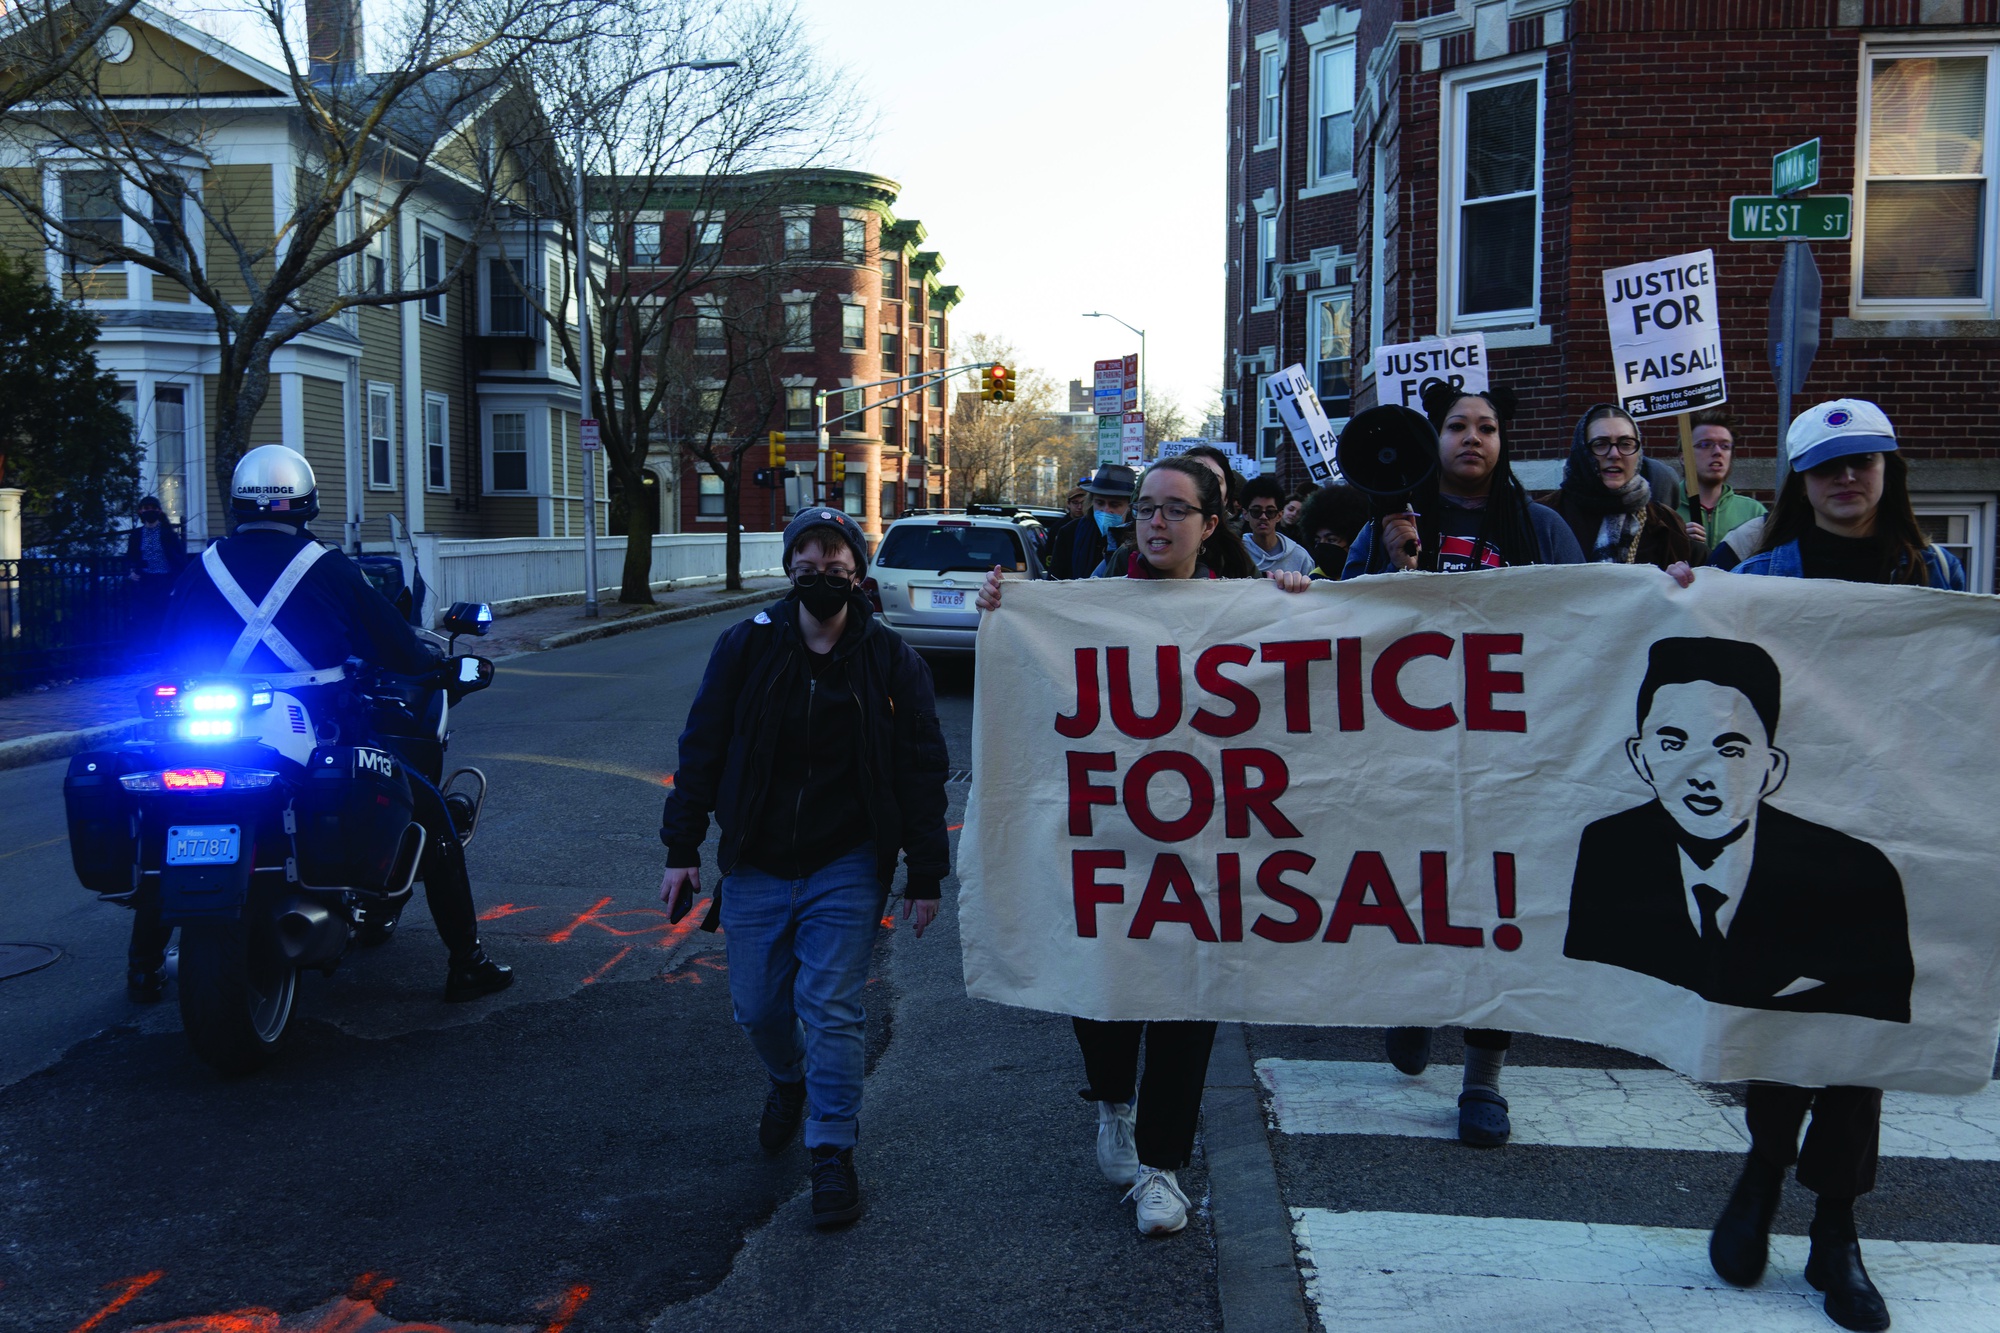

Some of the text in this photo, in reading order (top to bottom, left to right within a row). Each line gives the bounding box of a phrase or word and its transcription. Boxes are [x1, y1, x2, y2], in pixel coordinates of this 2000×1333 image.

[1776, 153, 1816, 189] INMAN ST
[1742, 204, 1844, 232] WEST ST
[1612, 262, 1709, 303] JUSTICE
[1632, 294, 1704, 335] FOR
[1383, 345, 1479, 376] JUSTICE
[1624, 344, 1718, 384] FAISAL!
[1103, 371, 1121, 379] PARKING
[1650, 382, 1719, 404] Party for Socialism and
[1628, 402, 1648, 414] PSL
[1651, 399, 1688, 411] Liberation
[1100, 417, 1106, 428] 2
[1124, 413, 1143, 422] TOW ZONE
[237, 486, 294, 494] CAMBRIDGE
[1443, 561, 1467, 570] Part
[954, 596, 964, 605] 89
[1055, 632, 1528, 740] JUSTICE
[358, 749, 392, 777] M13
[1067, 747, 1304, 842] FOR
[186, 829, 204, 837] Mass
[177, 838, 231, 856] M7787
[1071, 848, 1523, 951] FAISAL!
